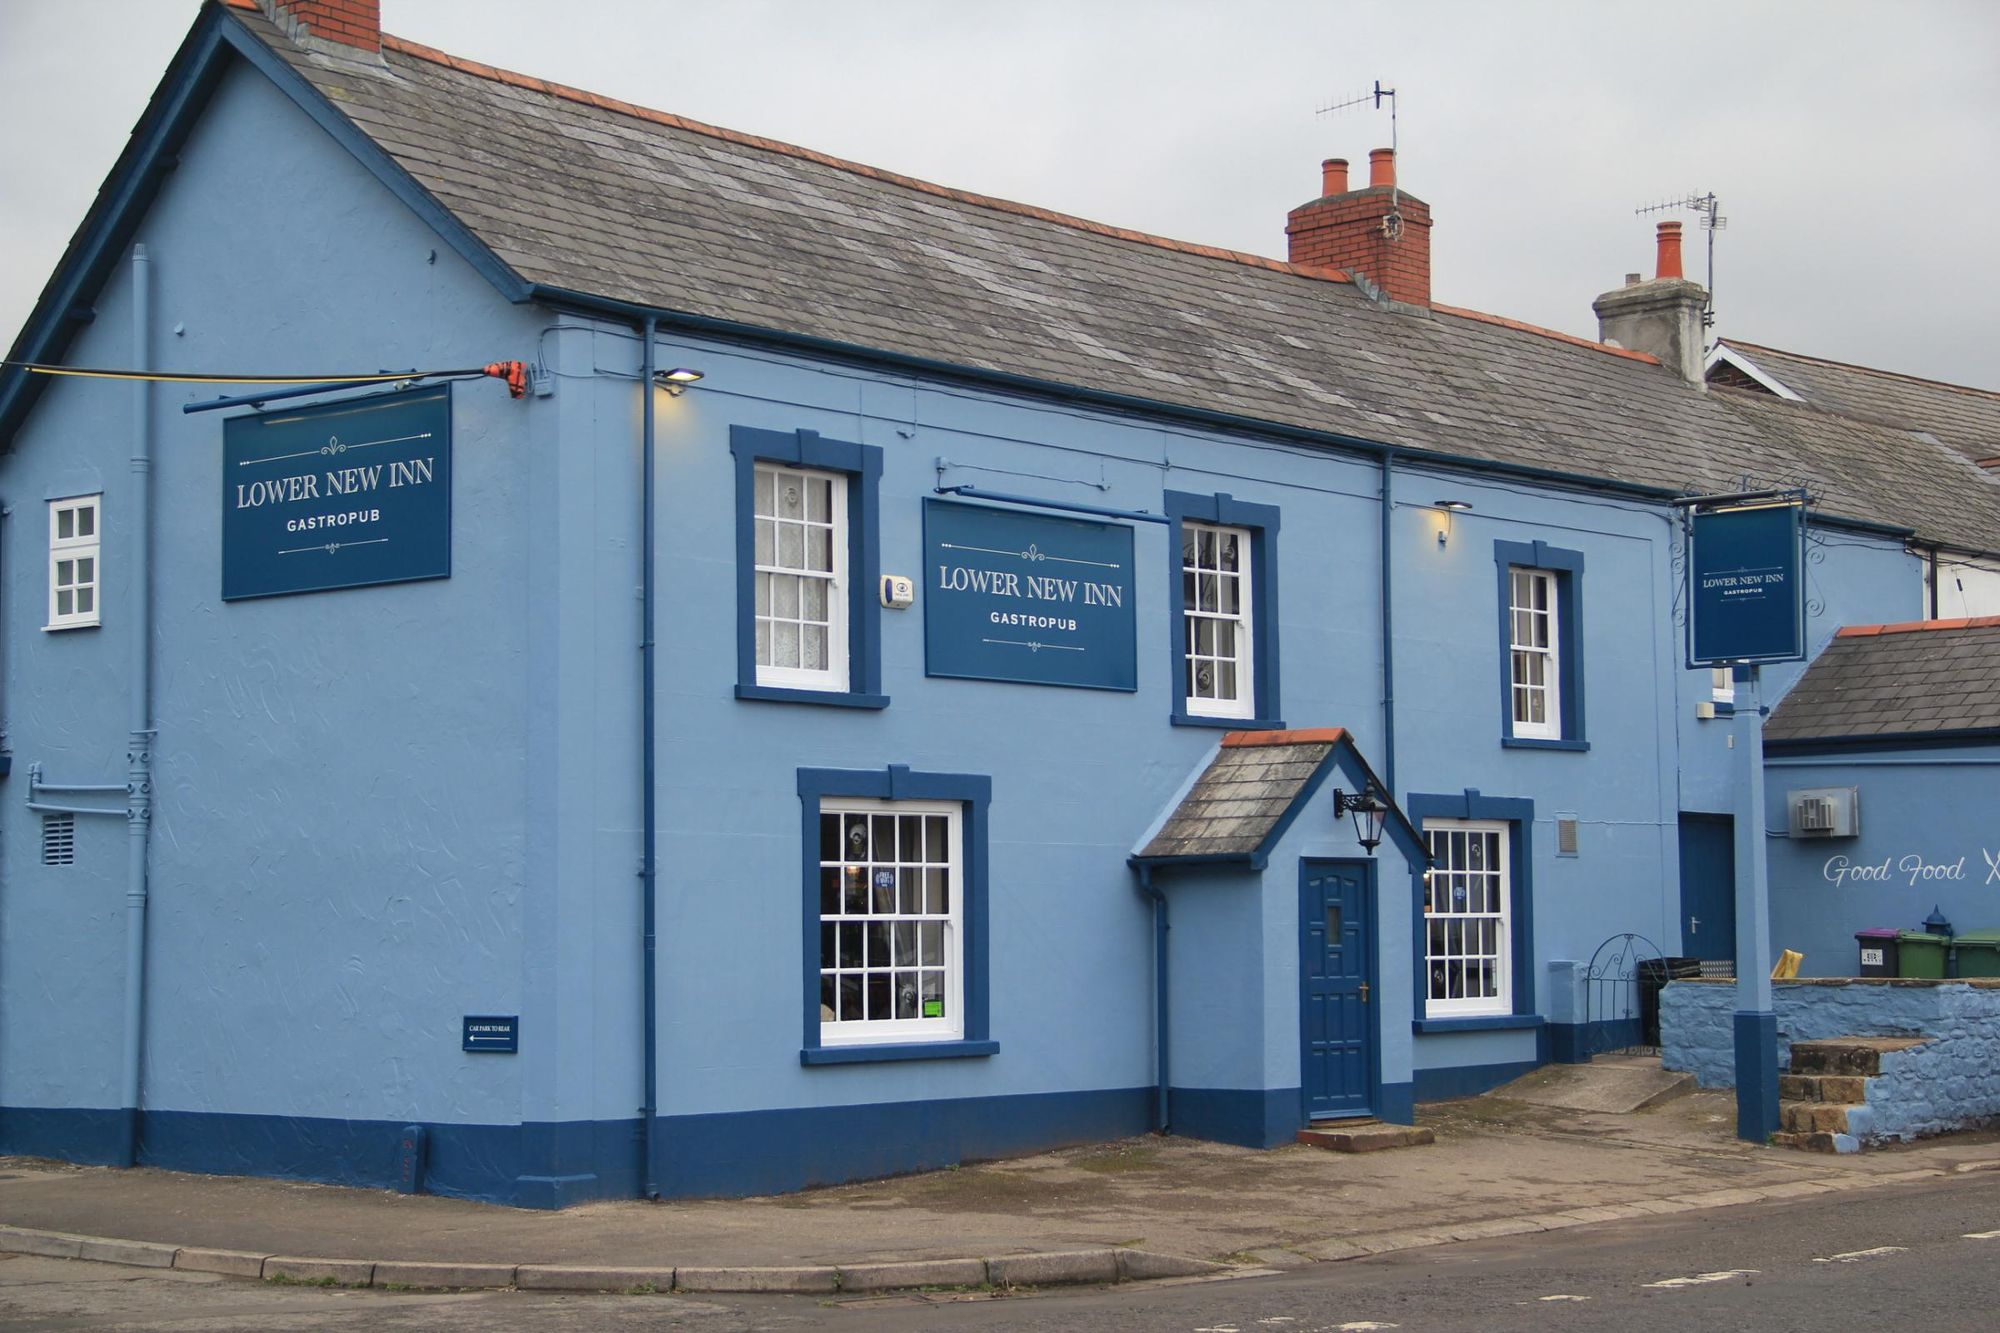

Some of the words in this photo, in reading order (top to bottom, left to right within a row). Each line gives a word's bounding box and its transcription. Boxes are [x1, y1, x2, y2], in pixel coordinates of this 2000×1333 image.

[237, 474, 319, 508] LOWER
[326, 465, 382, 496] NEW
[389, 457, 434, 487] INN
[287, 509, 380, 531] GASTROPUB
[939, 566, 1020, 597] LOWER
[1027, 576, 1077, 602] NEW
[1084, 582, 1122, 607] INN
[1703, 577, 1737, 588] LOWER
[1740, 575, 1763, 585] NEW
[1765, 573, 1784, 582] INN
[990, 612, 1076, 631] GASTROPUB
[1823, 855, 1891, 888] Good
[1899, 854, 1966, 886] Food
